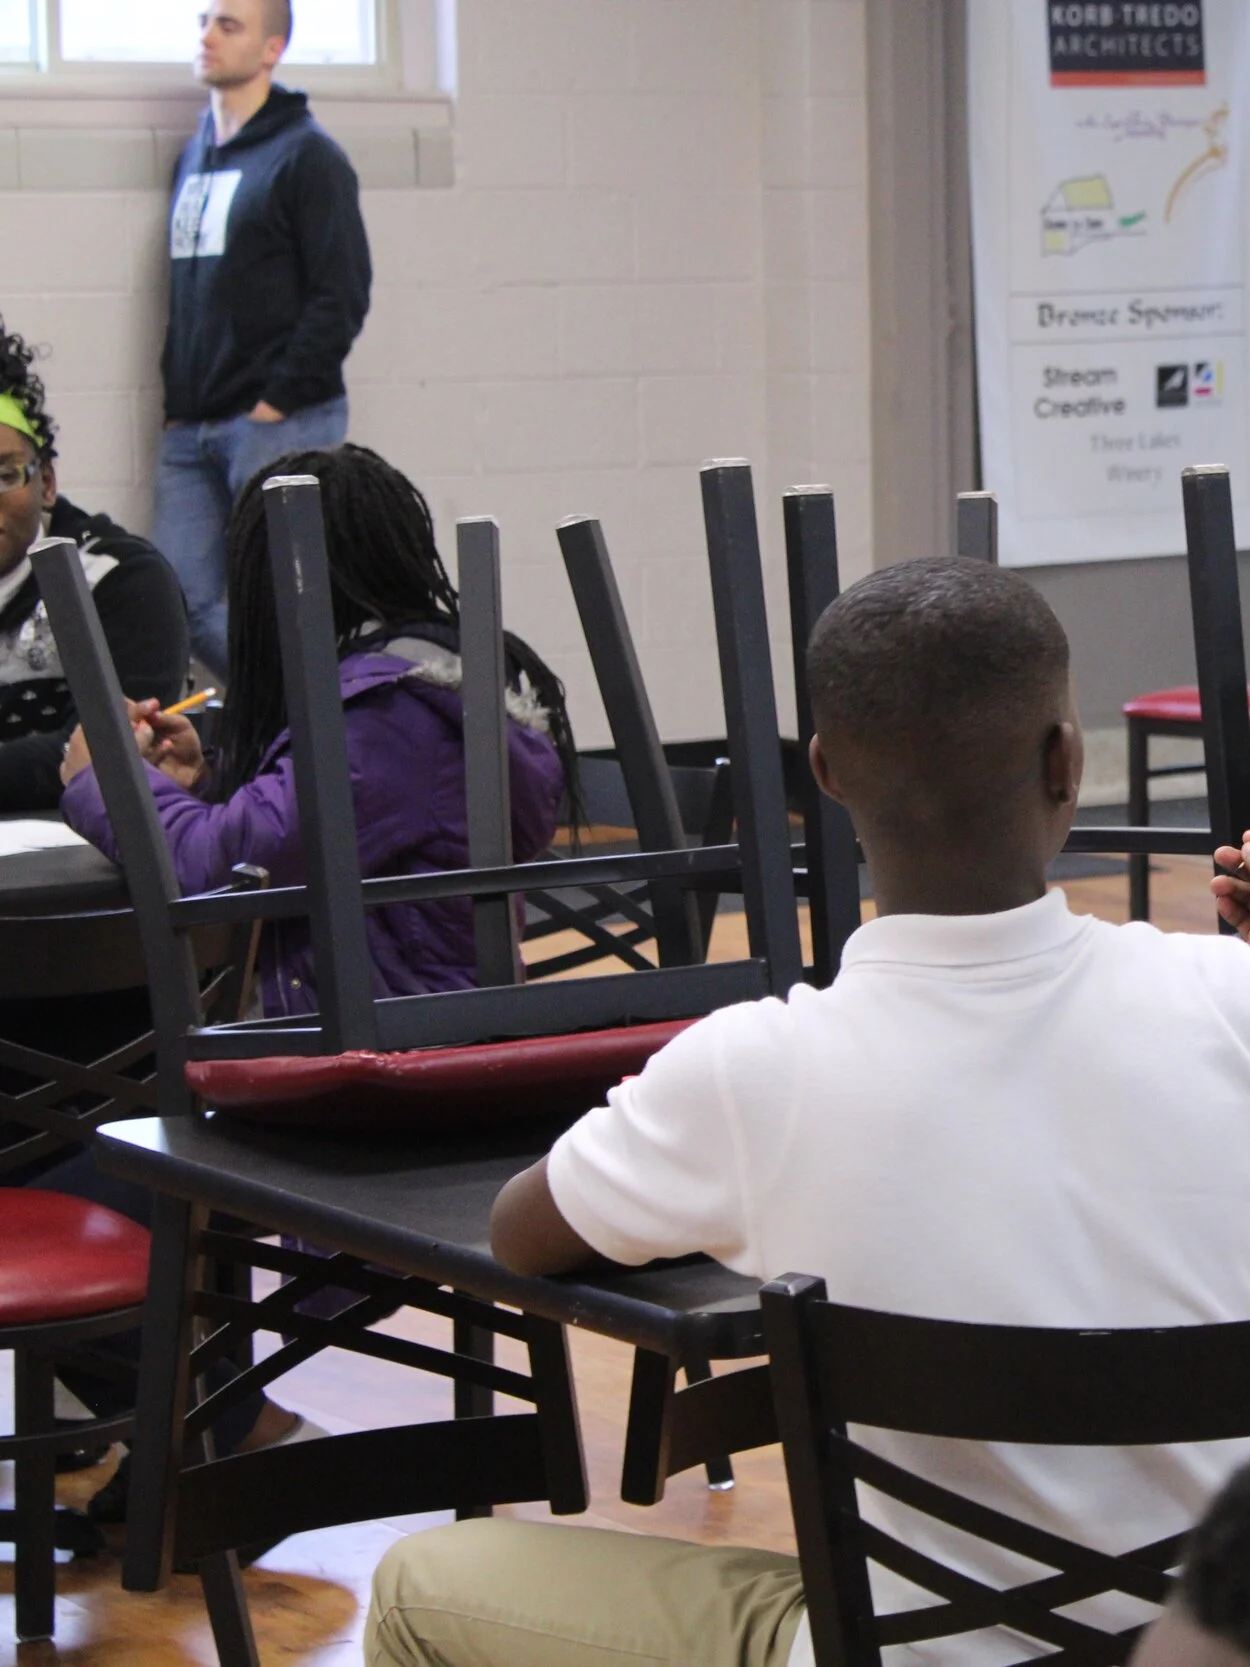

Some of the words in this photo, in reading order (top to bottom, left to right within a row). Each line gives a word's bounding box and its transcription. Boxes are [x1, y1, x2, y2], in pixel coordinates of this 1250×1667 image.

[1054, 33, 1199, 56] ARCHITECTS
[1044, 367, 1118, 387] Stream
[1034, 399, 1126, 418] Creative
